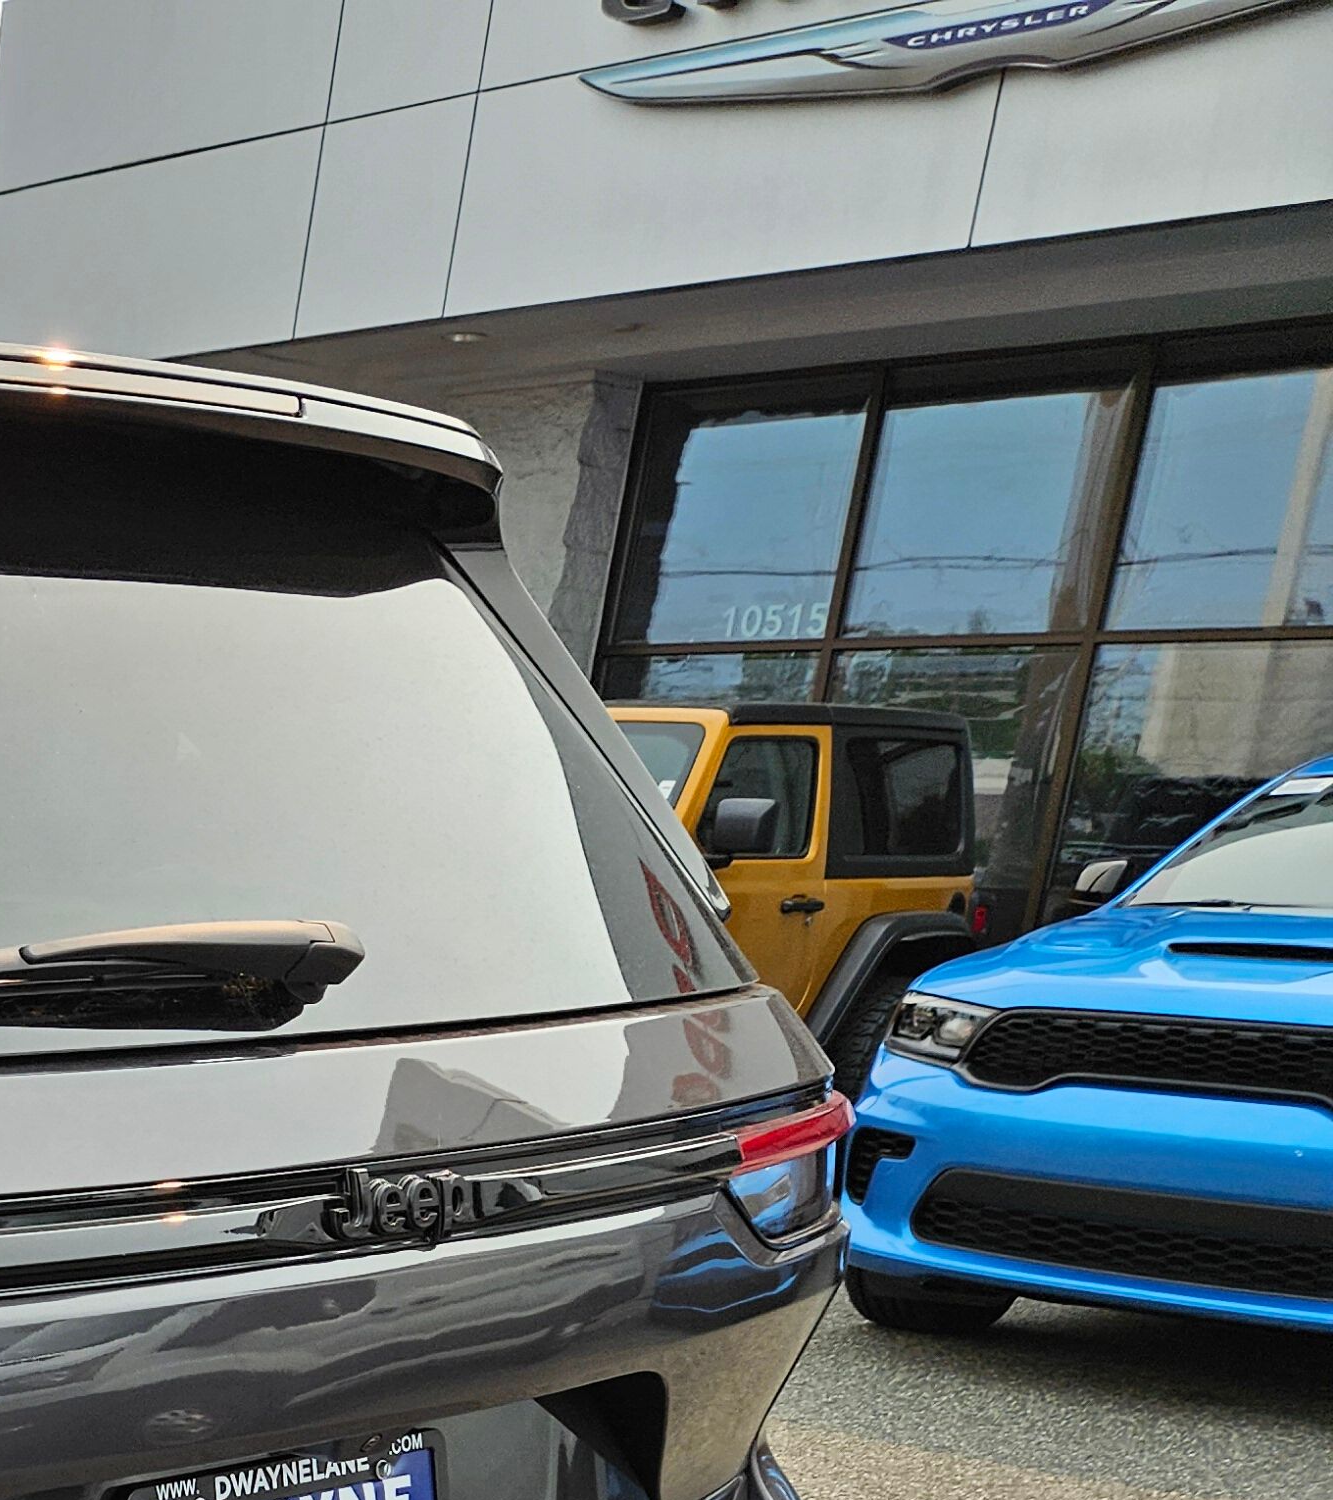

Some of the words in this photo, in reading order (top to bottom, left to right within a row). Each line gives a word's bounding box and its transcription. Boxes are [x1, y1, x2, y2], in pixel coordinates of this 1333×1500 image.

[907, 5, 1089, 47] CHRYSLER
[723, 602, 830, 638] 10515
[329, 1167, 475, 1240] Jeep
